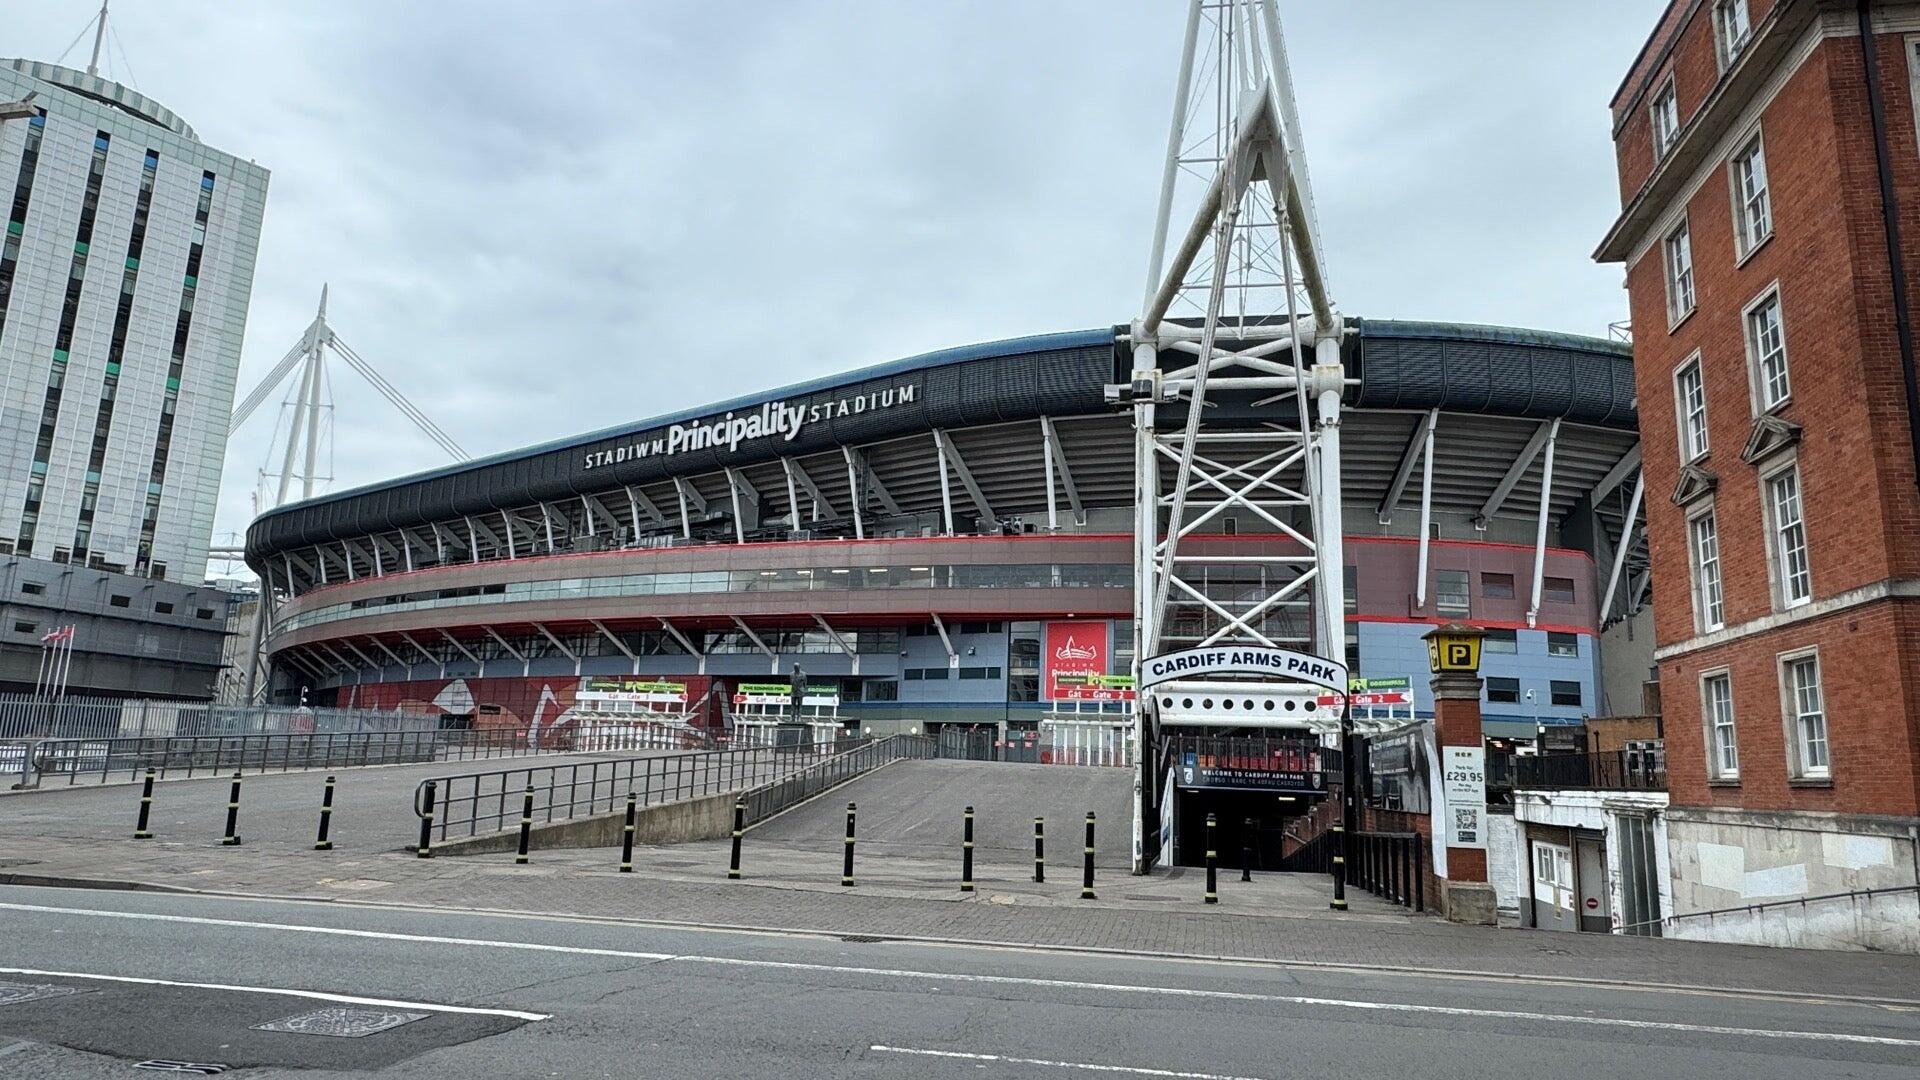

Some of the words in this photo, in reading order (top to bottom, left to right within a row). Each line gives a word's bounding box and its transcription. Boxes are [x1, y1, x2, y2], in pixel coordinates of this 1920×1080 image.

[585, 440, 663, 469] STADIWM
[667, 401, 807, 455] Principality
[811, 385, 914, 423] STADIUM
[1452, 646, 1466, 664] P
[1152, 652, 1226, 675] CARDIFF
[1230, 652, 1281, 668] ARMS
[1287, 658, 1337, 682] PARK
[1093, 690, 1112, 699] Gate
[1119, 691, 1124, 699] 2
[1355, 695, 1373, 704] Gate
[1378, 695, 1384, 703] 2
[1202, 769, 1233, 777] WELCOME
[1446, 771, 1483, 782] £29.95
